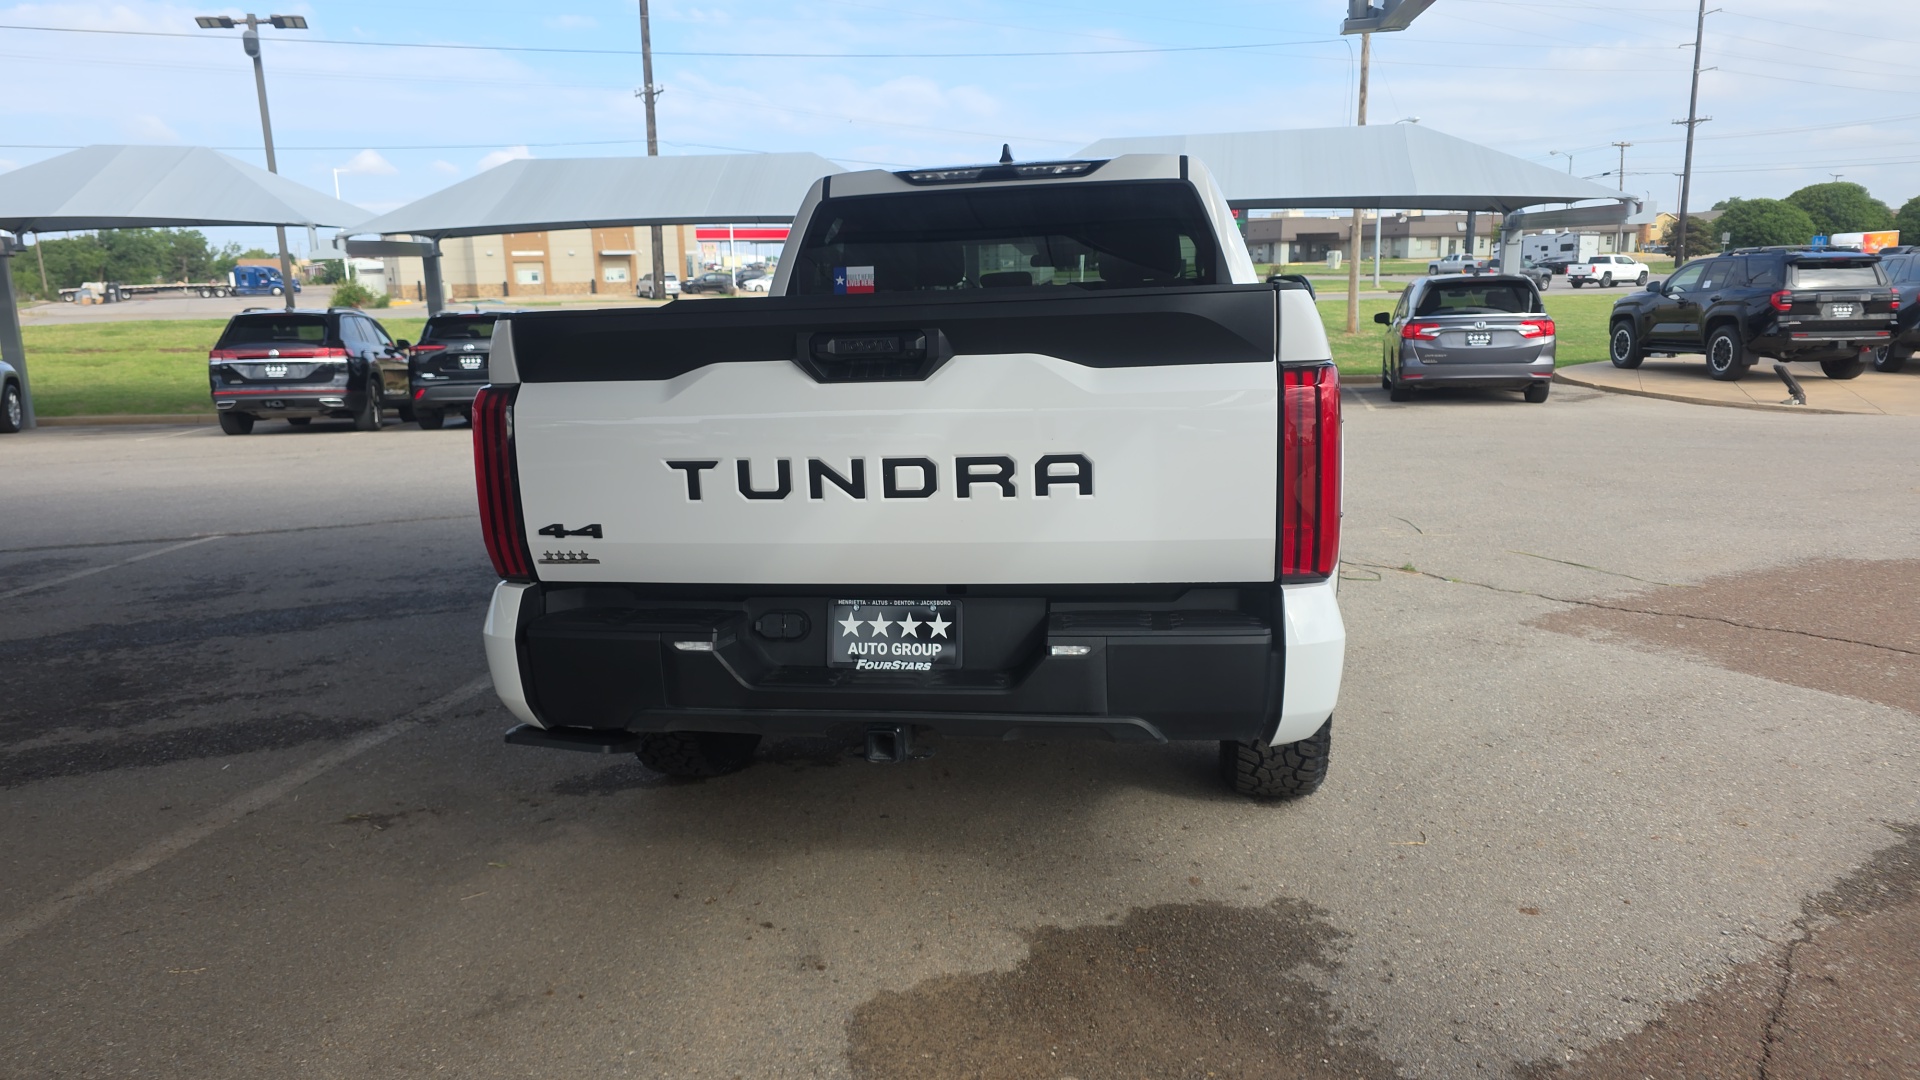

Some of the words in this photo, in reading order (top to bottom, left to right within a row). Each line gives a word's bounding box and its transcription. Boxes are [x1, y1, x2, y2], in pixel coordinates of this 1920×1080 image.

[664, 453, 1095, 501] TUNDRA
[847, 642, 888, 655] AUTO
[891, 642, 942, 656] GROUP
